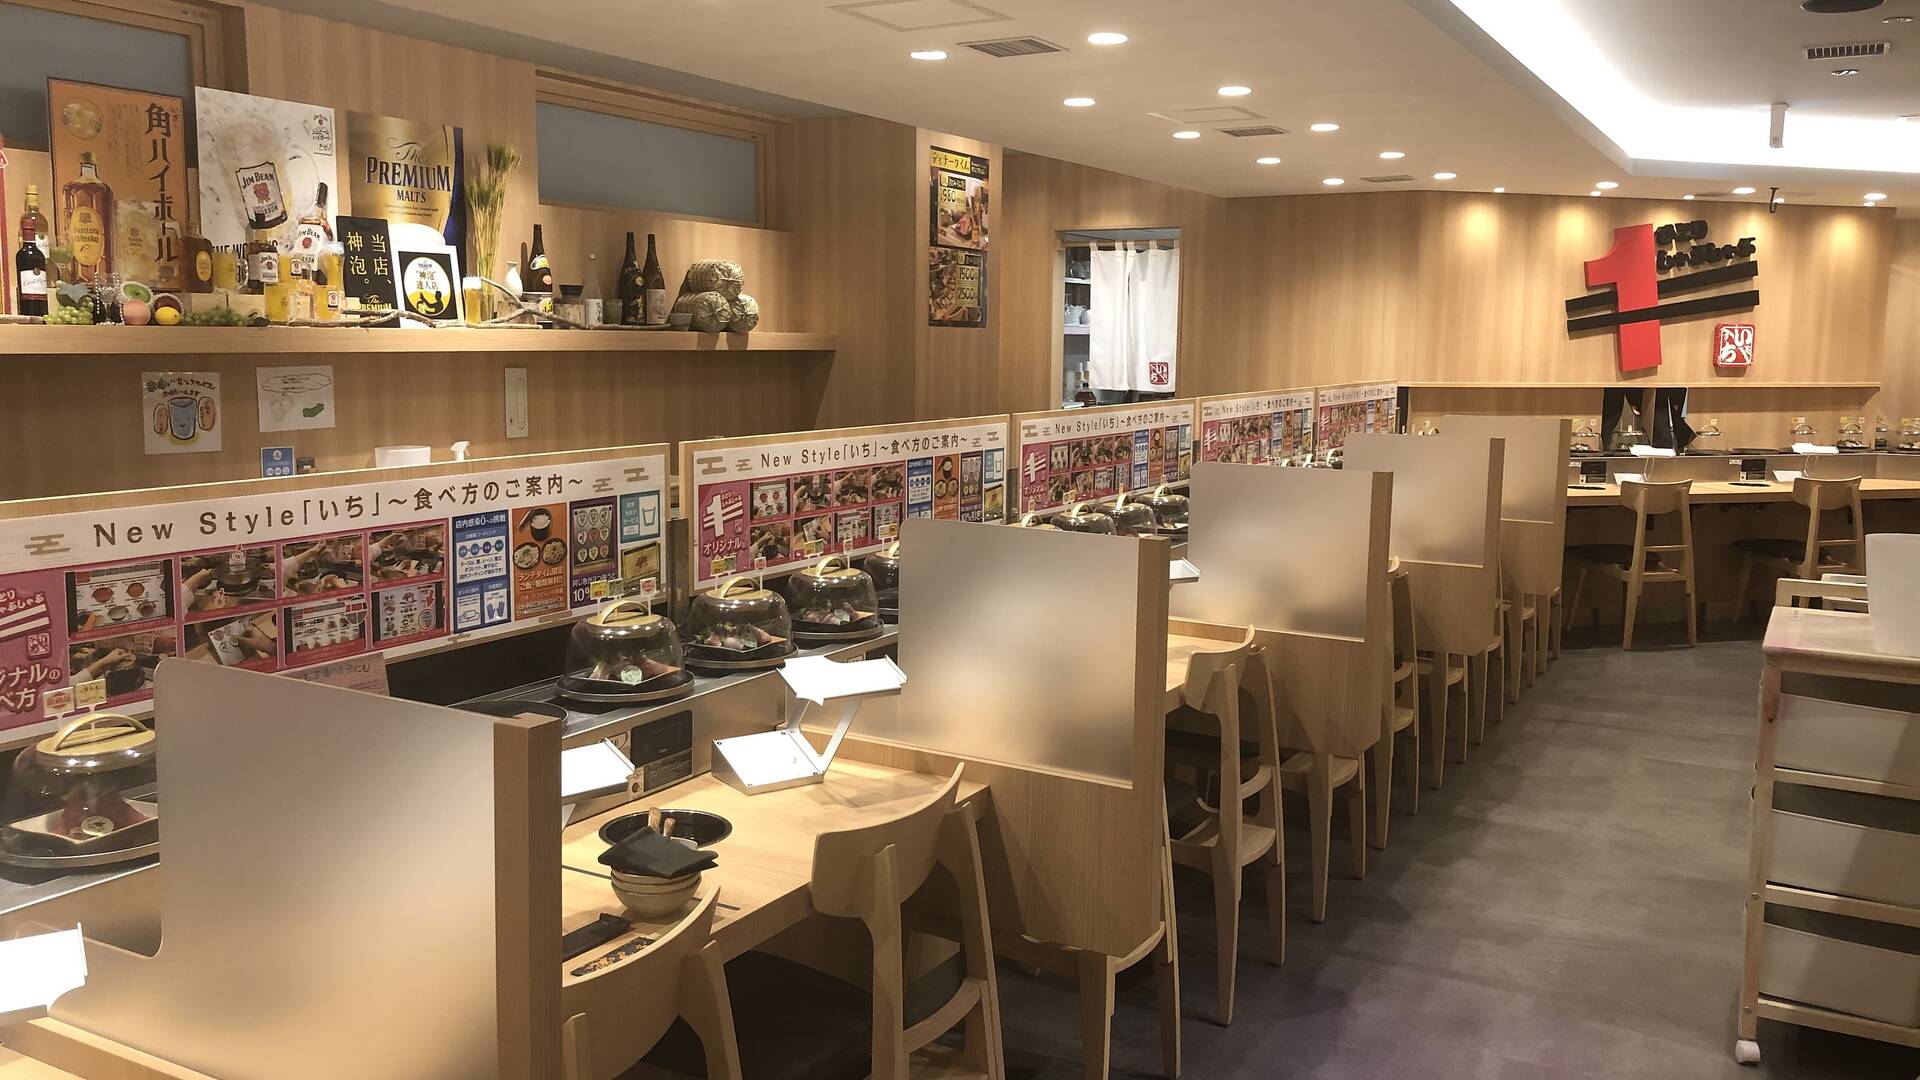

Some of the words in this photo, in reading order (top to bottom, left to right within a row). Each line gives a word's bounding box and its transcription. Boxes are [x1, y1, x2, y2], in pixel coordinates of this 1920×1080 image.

[242, 175, 255, 190] JIM
[255, 172, 275, 183] BEAM
[366, 156, 451, 192] PREMIUM
[396, 189, 426, 203] MALT'S
[346, 231, 370, 285] 神泡。
[371, 233, 392, 285] 当店、
[761, 451, 792, 468] New
[94, 522, 173, 547] New
